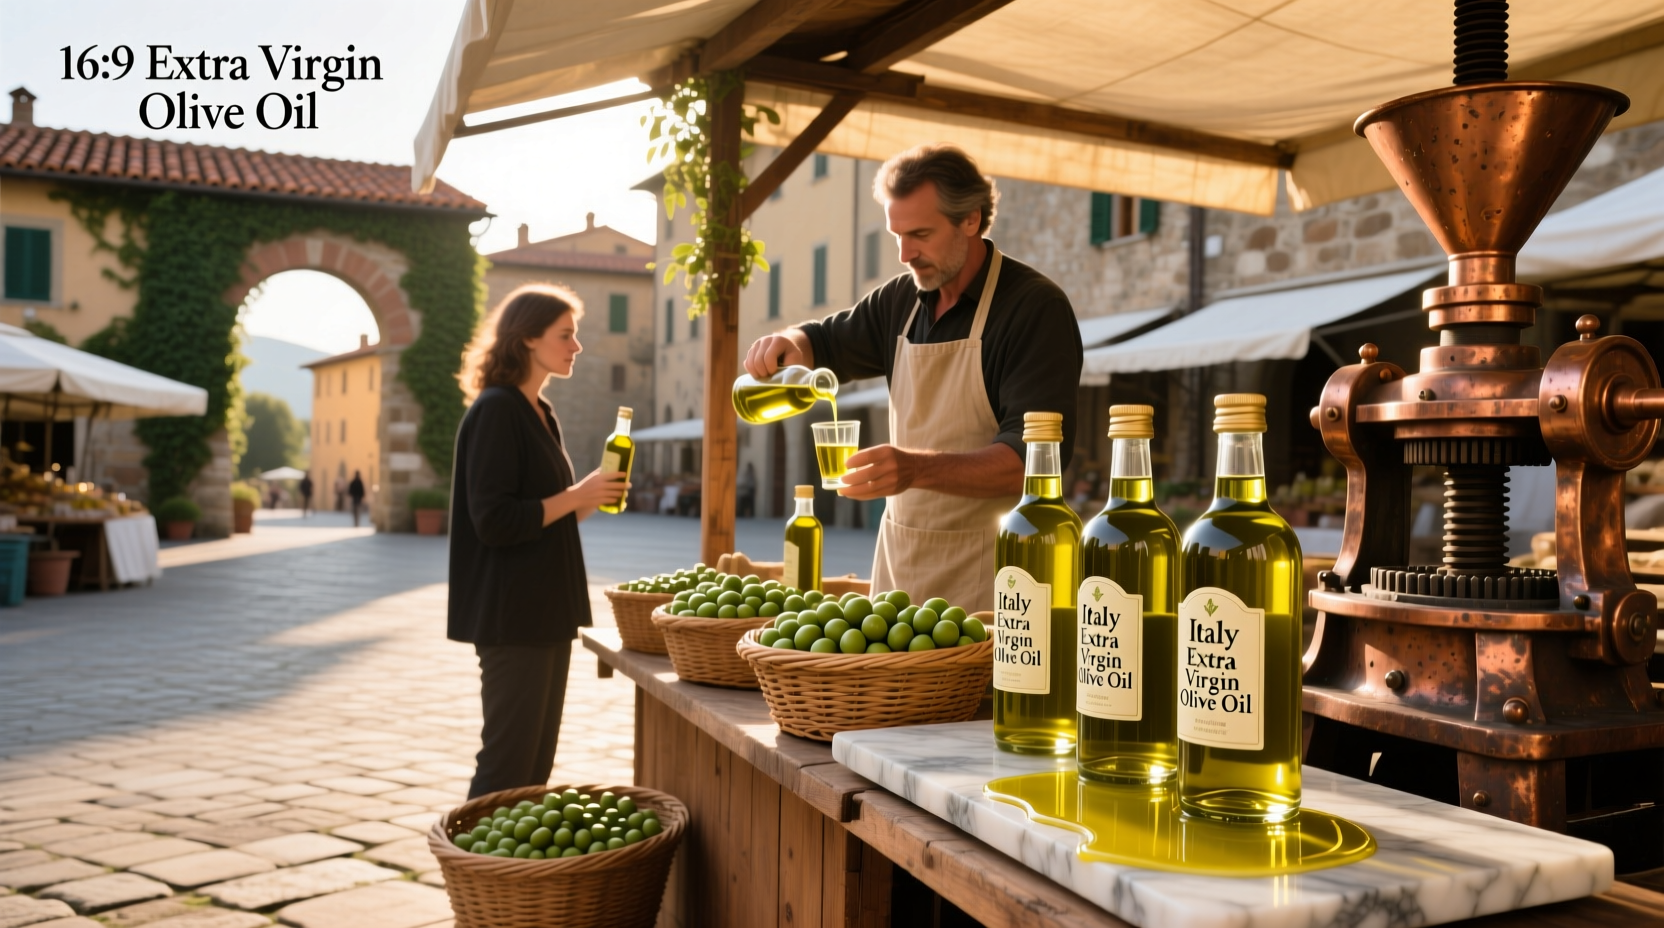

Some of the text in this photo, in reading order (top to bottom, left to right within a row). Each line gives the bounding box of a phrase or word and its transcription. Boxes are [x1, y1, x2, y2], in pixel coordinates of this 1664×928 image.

[998, 591, 1032, 616] Italy
[1082, 603, 1121, 633] Italy
[997, 629, 1033, 652] Vrgin
[1081, 627, 1119, 649] Extra
[1189, 618, 1240, 651] Italy
[1020, 650, 1041, 667] Oil
[1187, 647, 1237, 670] Extra
[1078, 667, 1132, 689] Olive Oil
[1185, 667, 1240, 696] Virgin
[1180, 688, 1253, 714] Olive Oil
